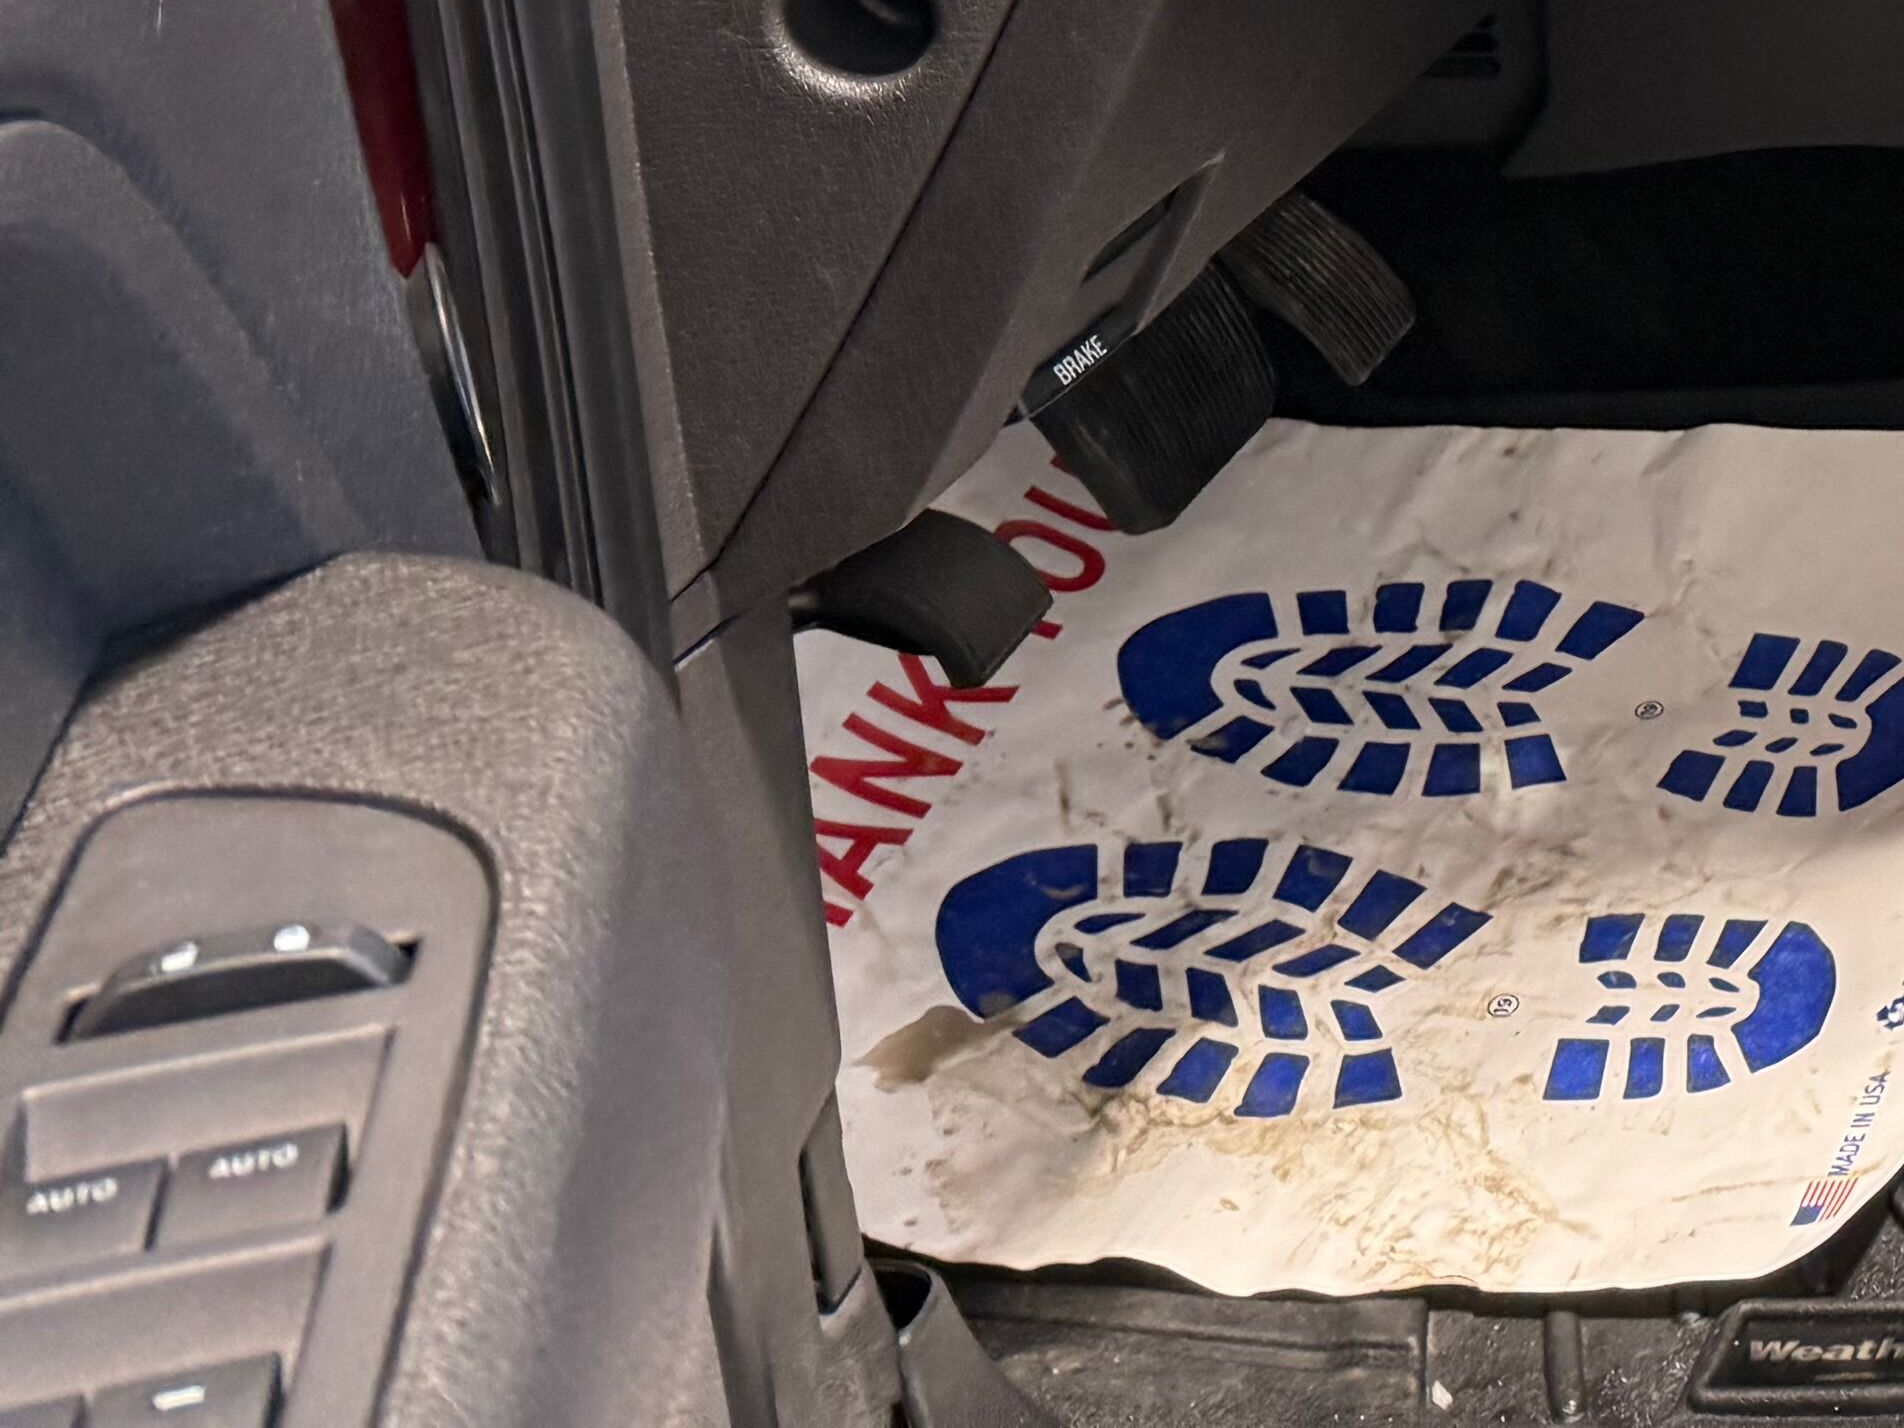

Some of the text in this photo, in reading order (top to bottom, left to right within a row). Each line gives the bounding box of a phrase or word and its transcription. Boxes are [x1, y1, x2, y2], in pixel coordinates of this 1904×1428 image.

[1053, 334, 1108, 386] BRAKE
[1827, 1068, 1892, 1177] MADE IN USA
[207, 1142, 299, 1180] AUTO
[26, 1177, 118, 1217] AUTO
